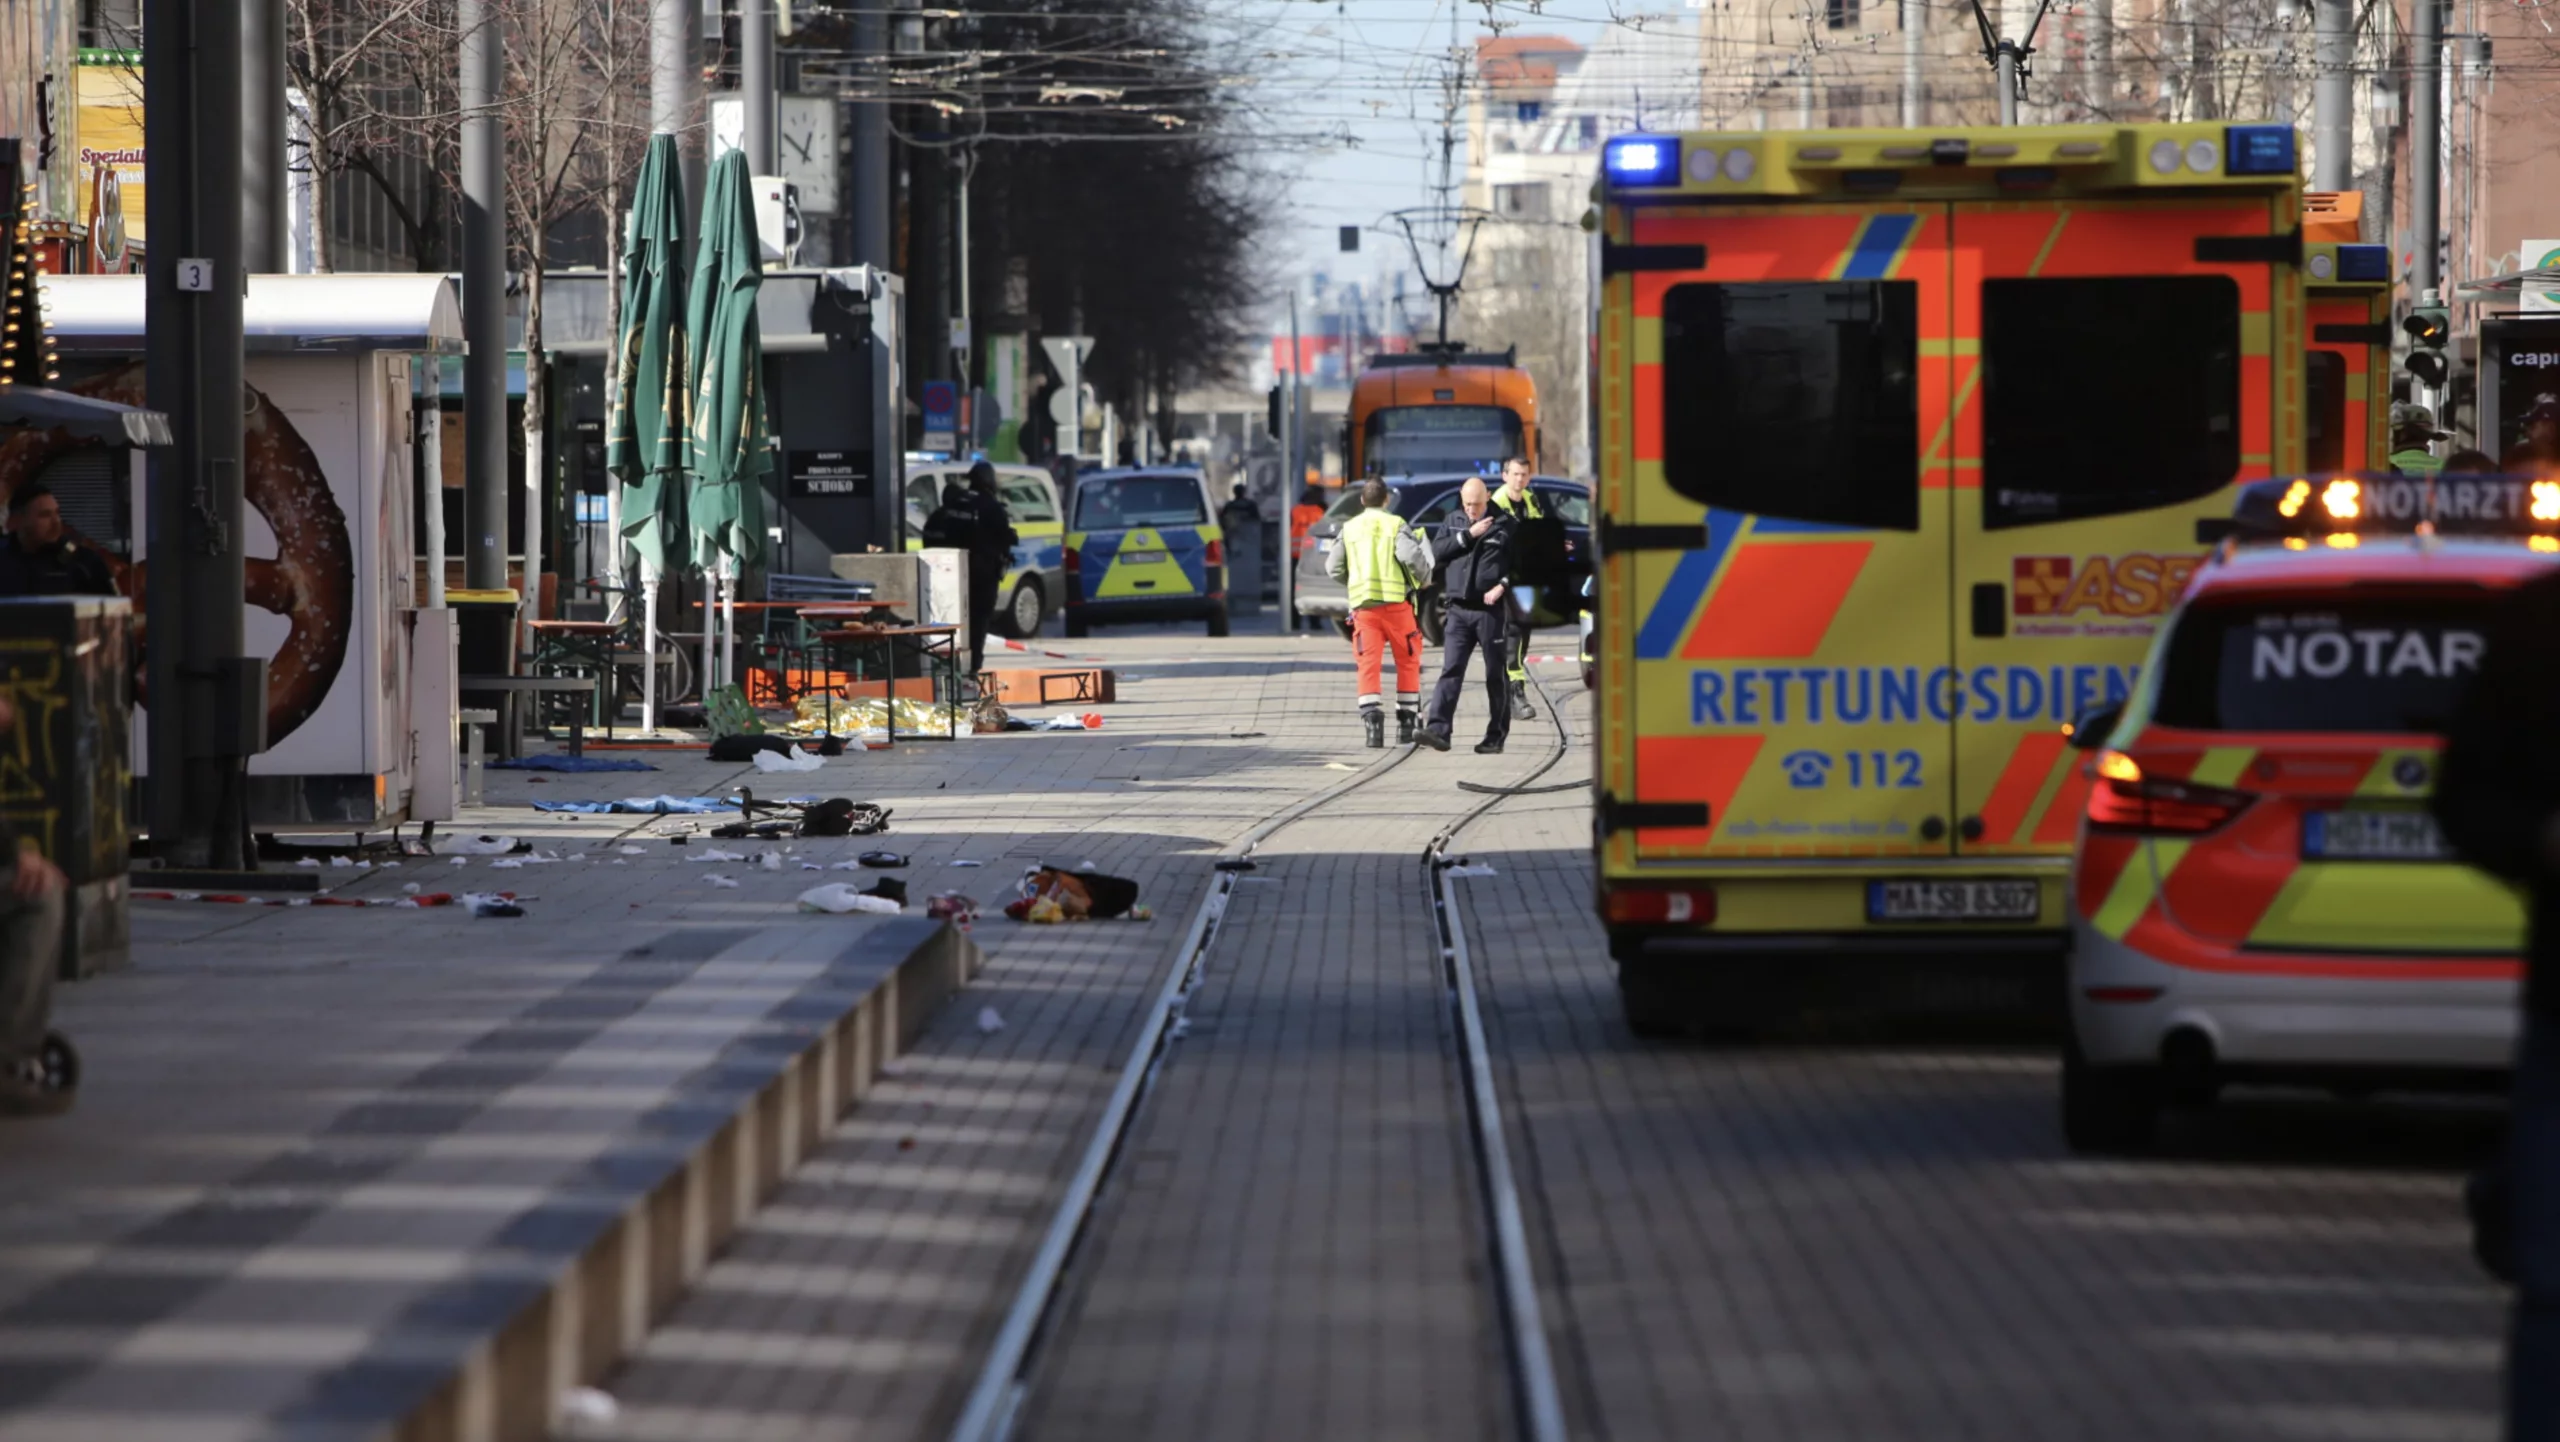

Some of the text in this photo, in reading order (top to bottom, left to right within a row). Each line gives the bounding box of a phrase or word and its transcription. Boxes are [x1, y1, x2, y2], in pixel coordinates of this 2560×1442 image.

[189, 265, 200, 288] 3
[807, 479, 854, 493] SCHOKO
[2363, 481, 2524, 519] NOTARZT
[1845, 749, 1925, 788] 112
